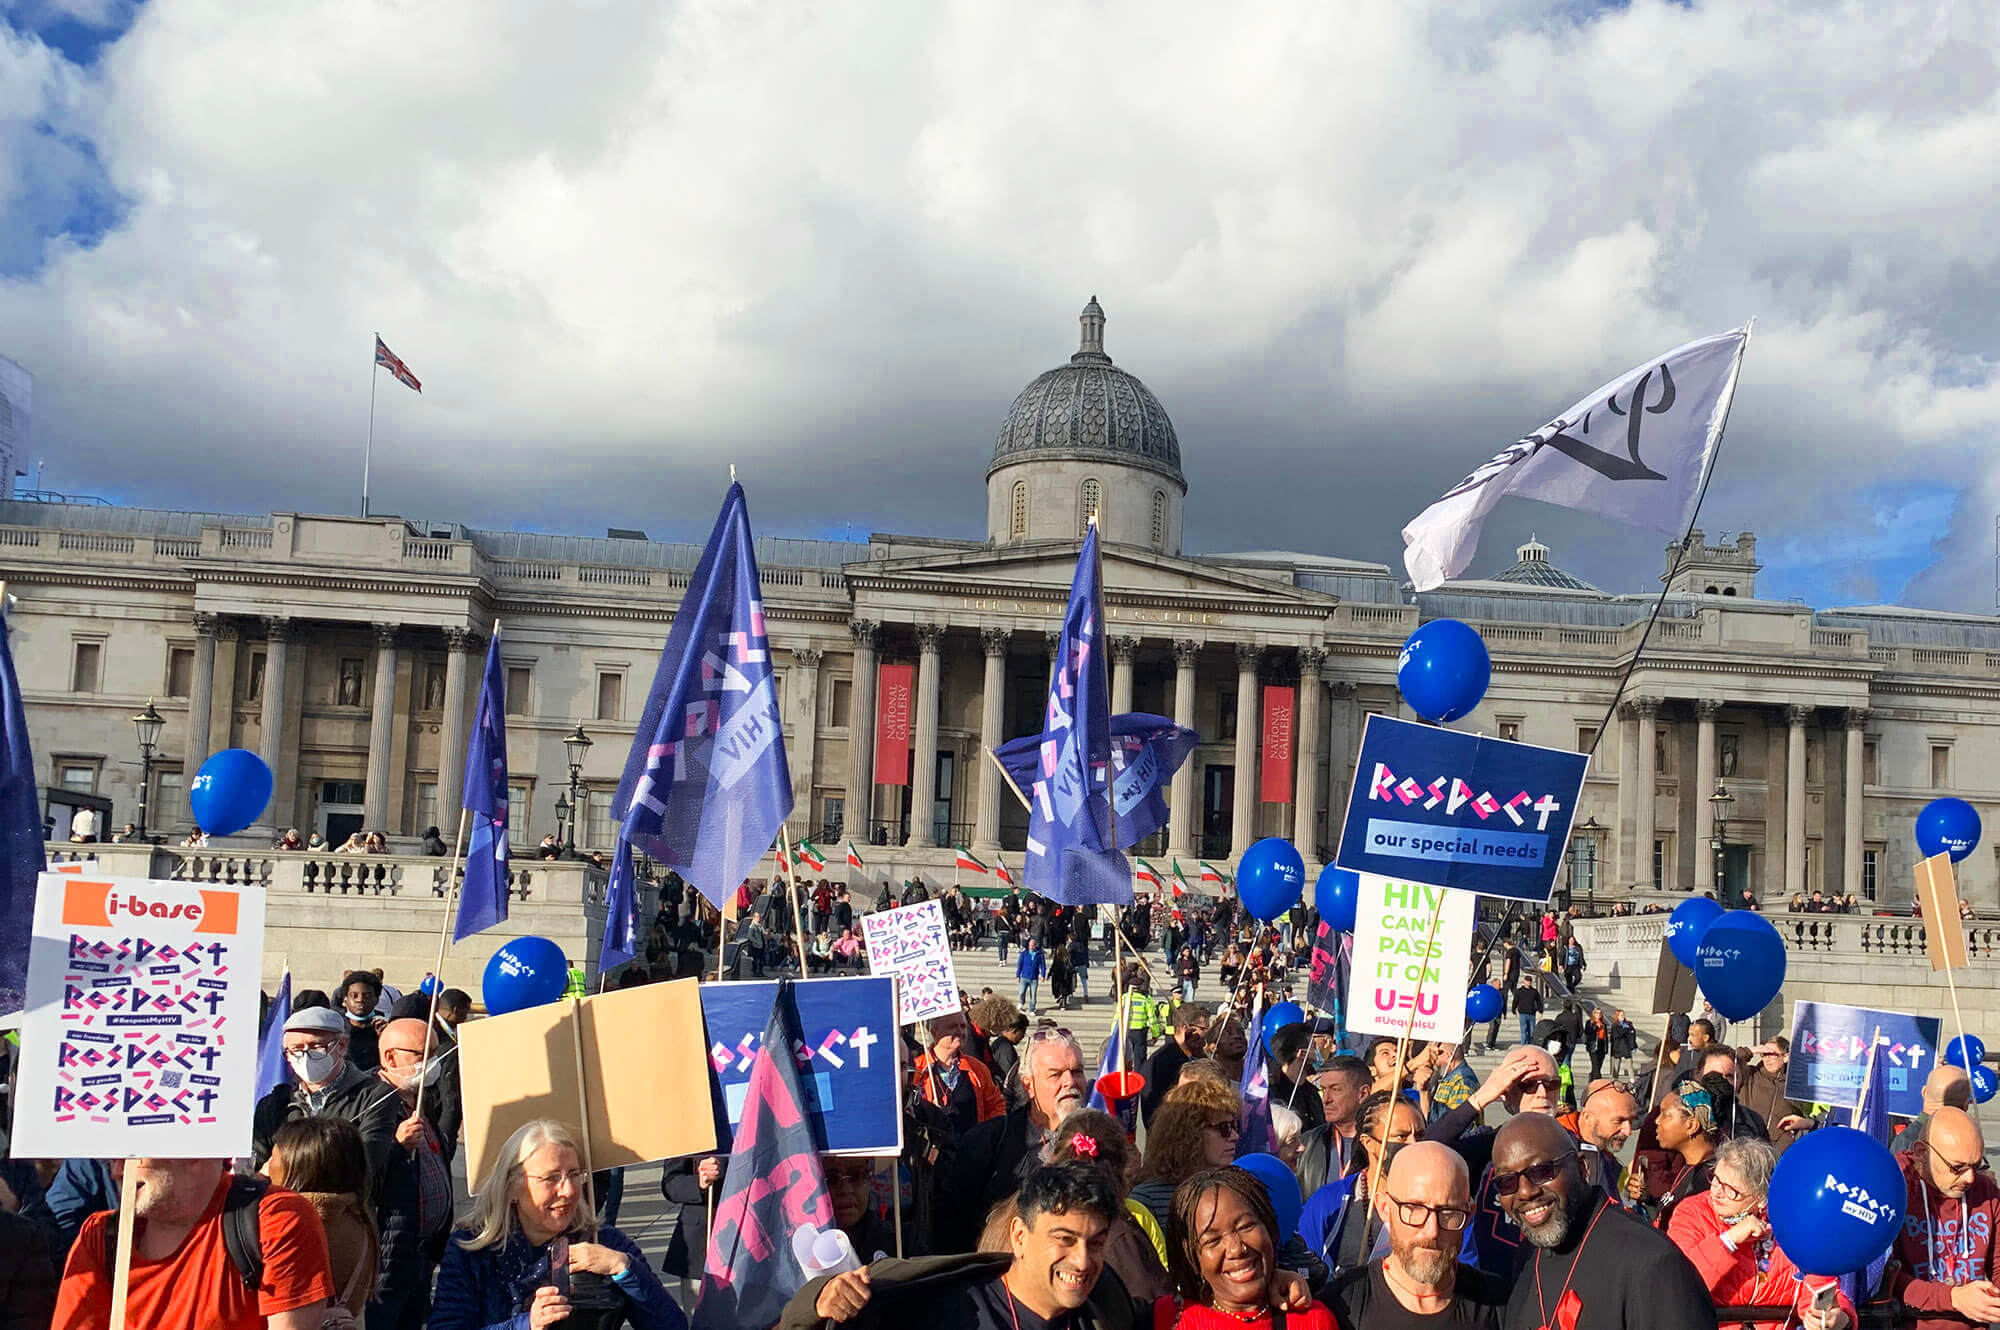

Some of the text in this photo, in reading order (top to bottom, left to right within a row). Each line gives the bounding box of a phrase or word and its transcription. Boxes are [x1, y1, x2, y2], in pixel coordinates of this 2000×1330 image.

[888, 685, 897, 739] NATIONAL
[896, 685, 907, 740] GALLERY
[1270, 706, 1280, 759] NATIONAL
[1279, 706, 1289, 760] GALLERY
[1374, 832, 1538, 859] our special needs
[110, 893, 202, 920] i-base
[1379, 936, 1443, 959] PASS
[1377, 962, 1440, 984] IT ON
[1374, 988, 1439, 1016] U=U
